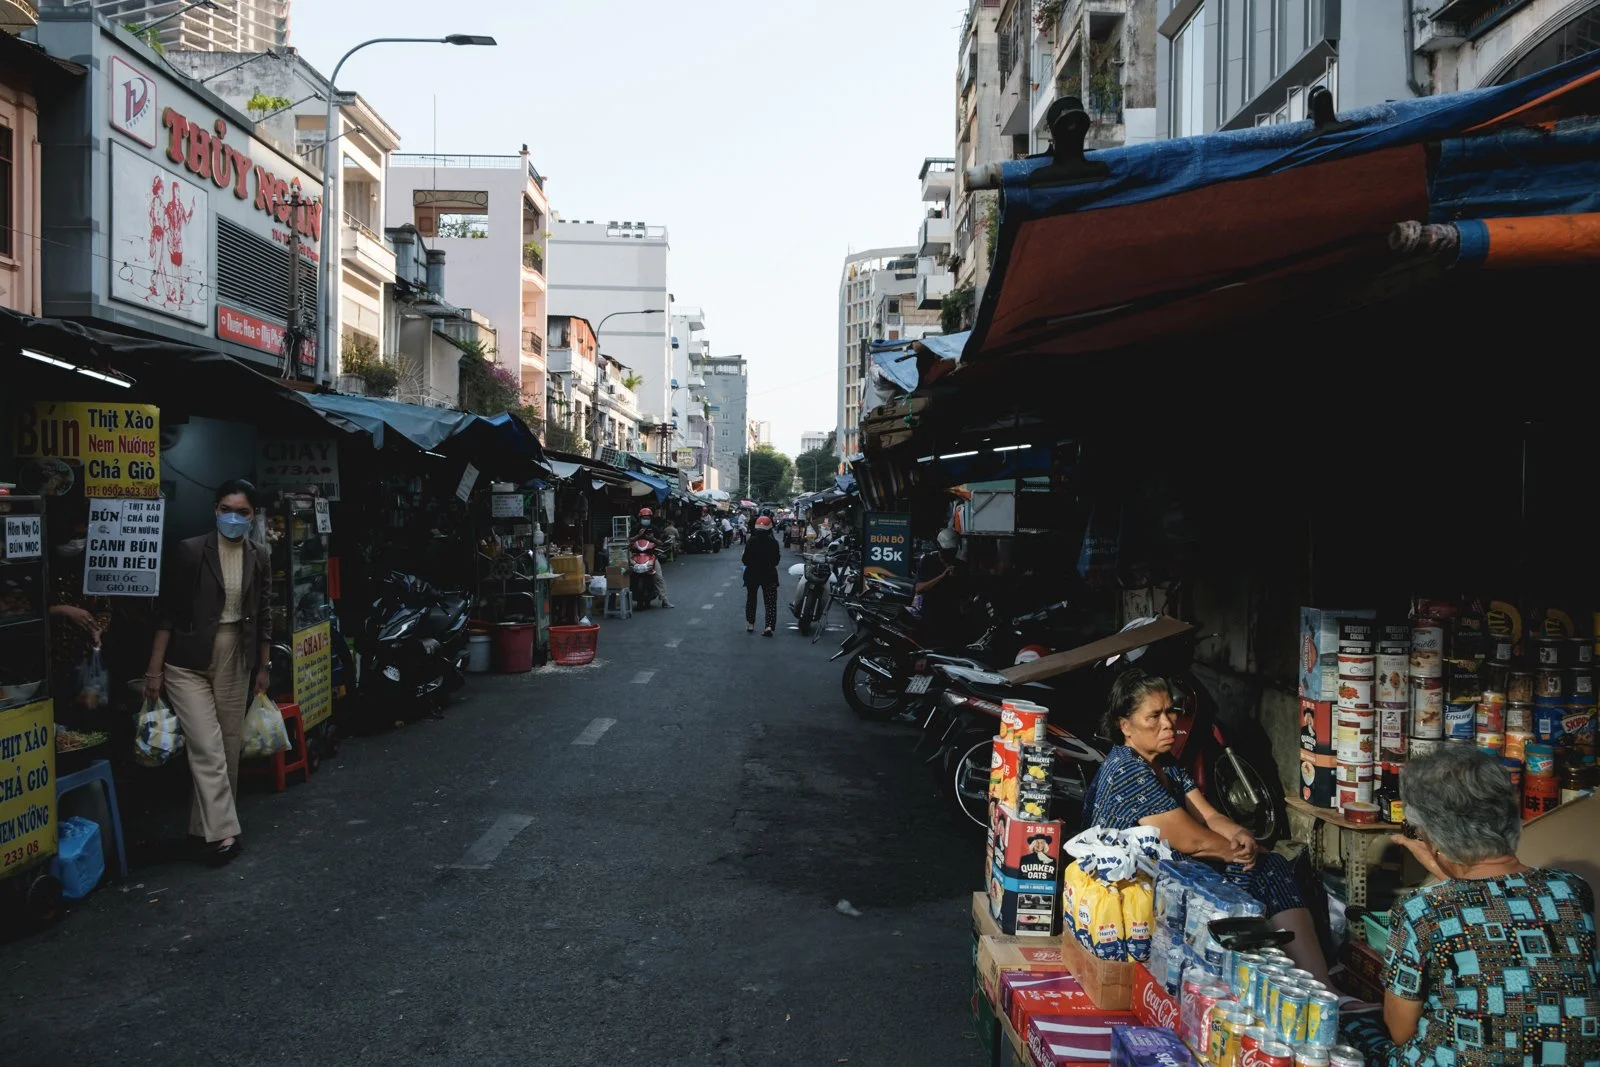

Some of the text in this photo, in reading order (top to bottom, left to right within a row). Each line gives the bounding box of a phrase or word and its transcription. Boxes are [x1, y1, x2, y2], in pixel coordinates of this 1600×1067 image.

[163, 106, 252, 200] THỦY
[243, 319, 255, 339] Hoa
[88, 409, 154, 432] Thịt Xào
[17, 404, 80, 457] Bún
[89, 434, 156, 457] Nem Nướng
[89, 459, 155, 480] Chả Giò
[277, 465, 320, 475] 73A
[91, 508, 119, 522] BÚN
[91, 538, 158, 553] CANH BÚN
[870, 532, 905, 544] BÚN BÒ
[89, 553, 157, 570] BÚN RIÊU
[870, 546, 904, 562] 35K
[1445, 712, 1471, 721] Ensure
[1565, 716, 1590, 731] SKIPPY
[27, 760, 48, 792] GIÒ
[18, 804, 49, 834] NƯỚNG
[4, 839, 39, 866] 233 08
[1020, 863, 1055, 874] QUAKER
